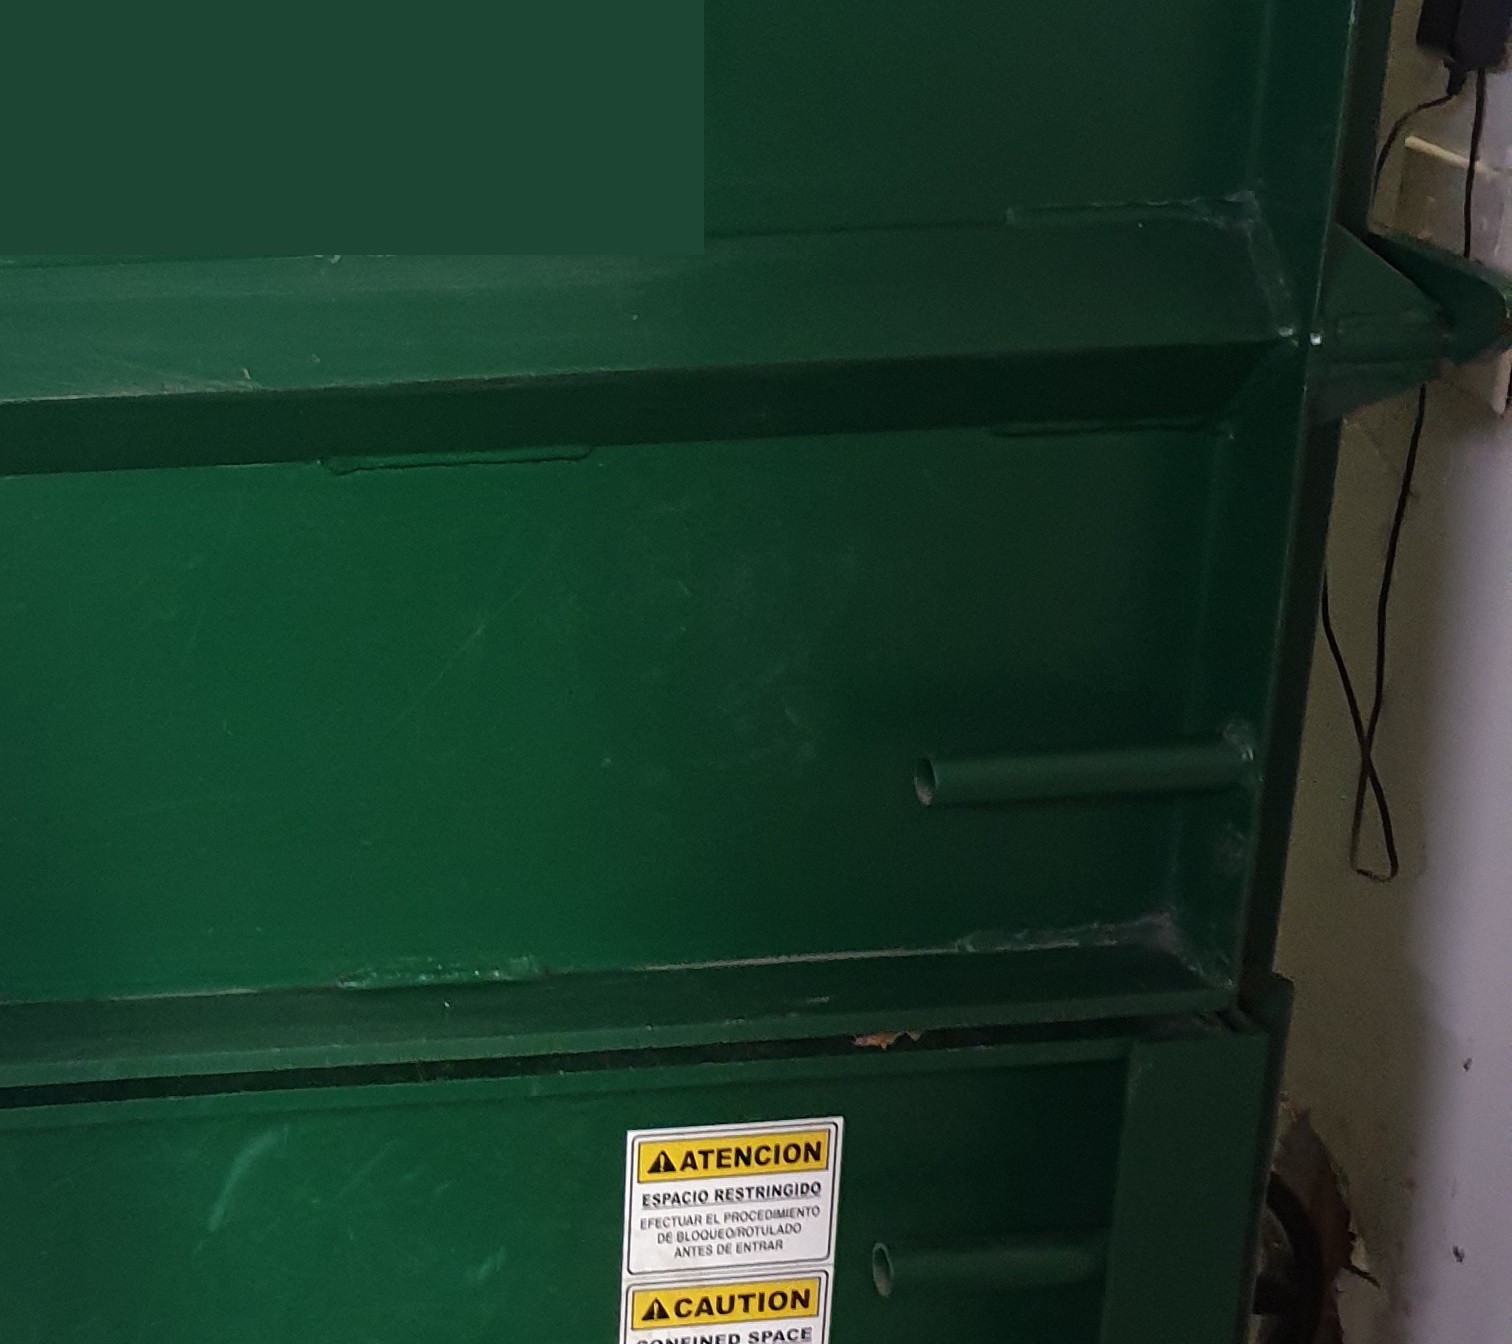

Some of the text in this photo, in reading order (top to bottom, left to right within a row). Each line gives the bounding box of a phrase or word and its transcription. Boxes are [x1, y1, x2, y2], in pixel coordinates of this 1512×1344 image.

[680, 1141, 821, 1172] ATENCION
[642, 1181, 821, 1207] ESPACIO RESTRINGIDO
[640, 1205, 820, 1229] EFECTUAR EL PROCEDIMIENTO
[658, 1232, 672, 1244] DE
[674, 1239, 783, 1258] ANTES DE ENTRAR
[674, 1288, 810, 1318] CAUTION
[748, 1327, 812, 1344] SPACE
